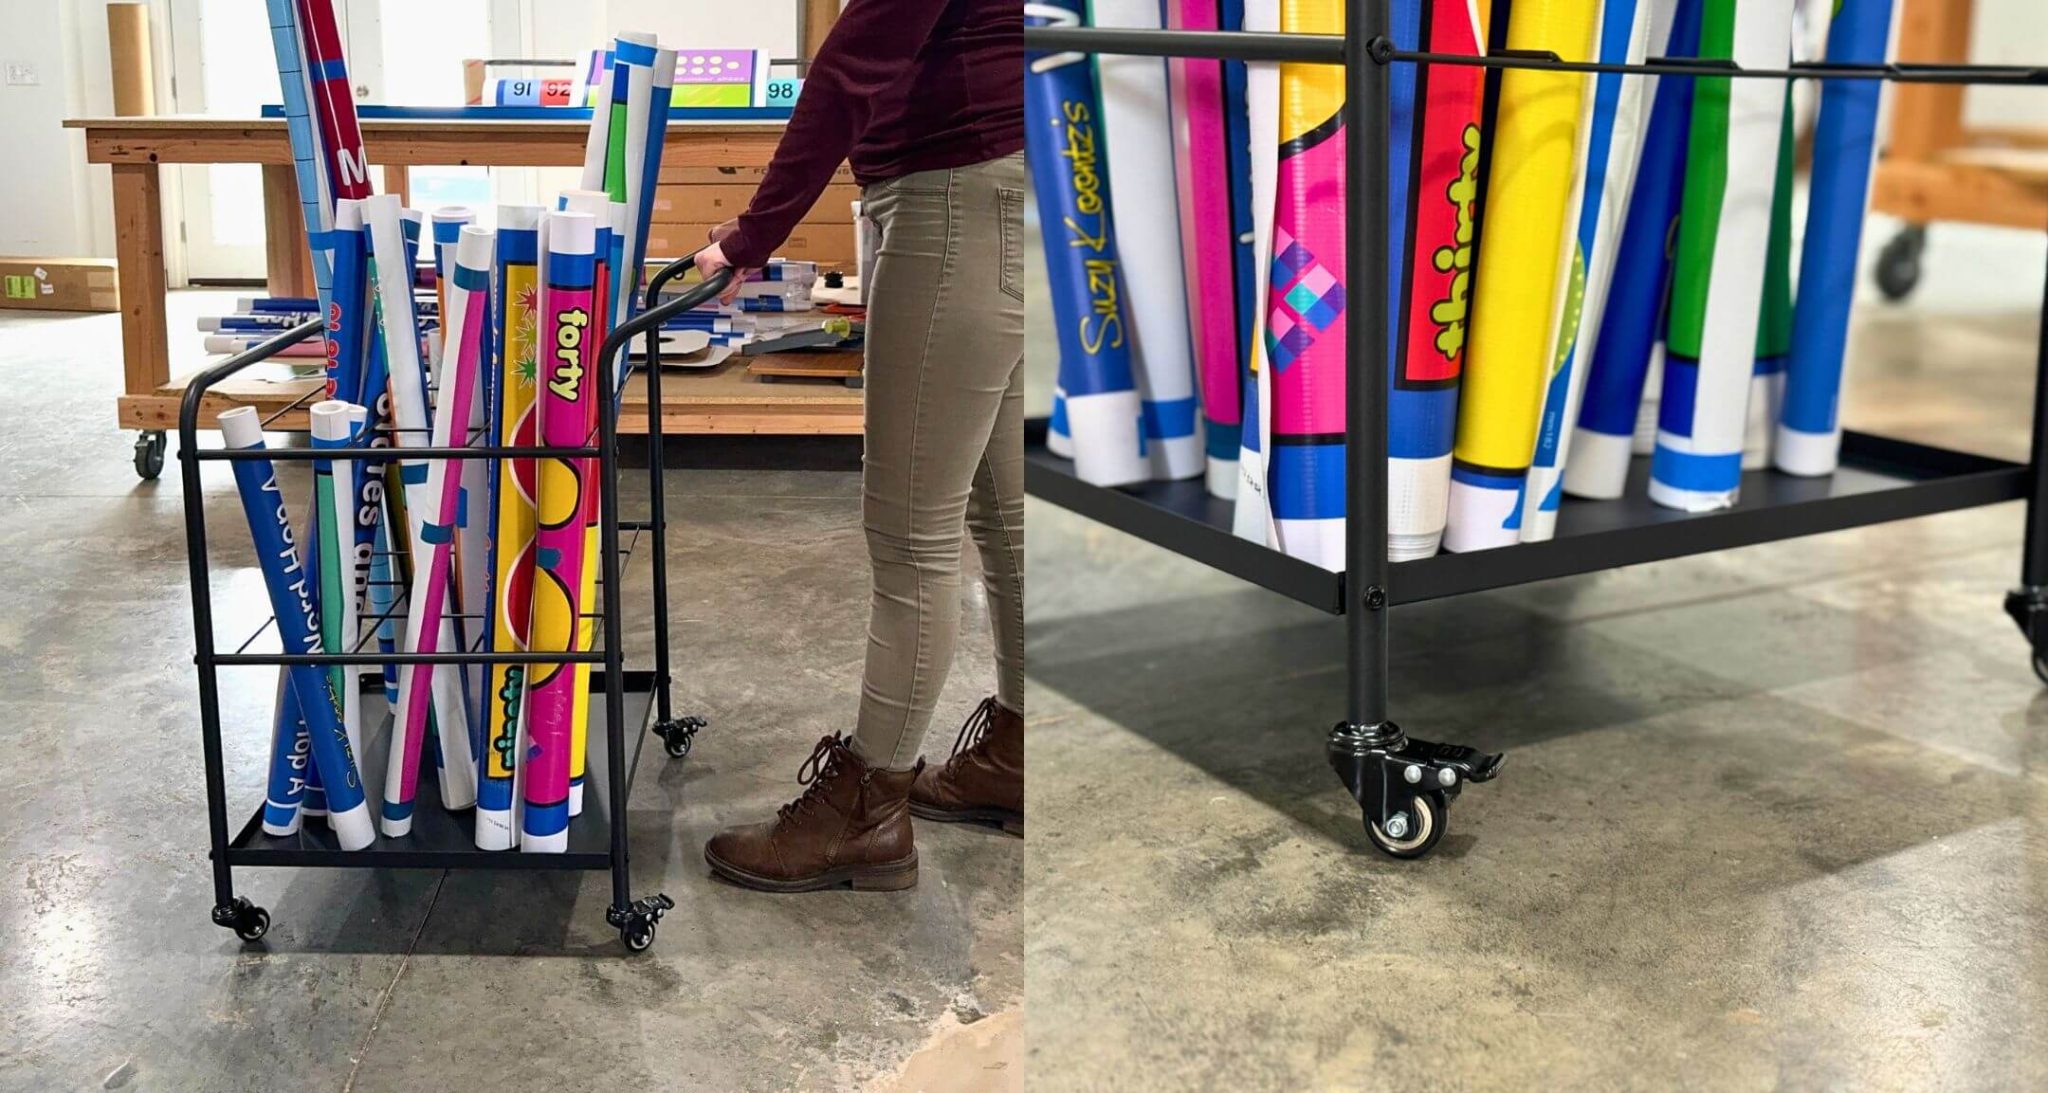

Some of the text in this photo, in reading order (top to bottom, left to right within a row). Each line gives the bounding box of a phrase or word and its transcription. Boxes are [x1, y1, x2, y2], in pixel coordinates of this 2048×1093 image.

[513, 82, 571, 97] 91 92
[768, 83, 793, 98] 98
[1430, 122, 1481, 360] thirty
[1079, 257, 1122, 355] Suzy
[547, 307, 589, 402] forty
[495, 666, 524, 769] ninety
